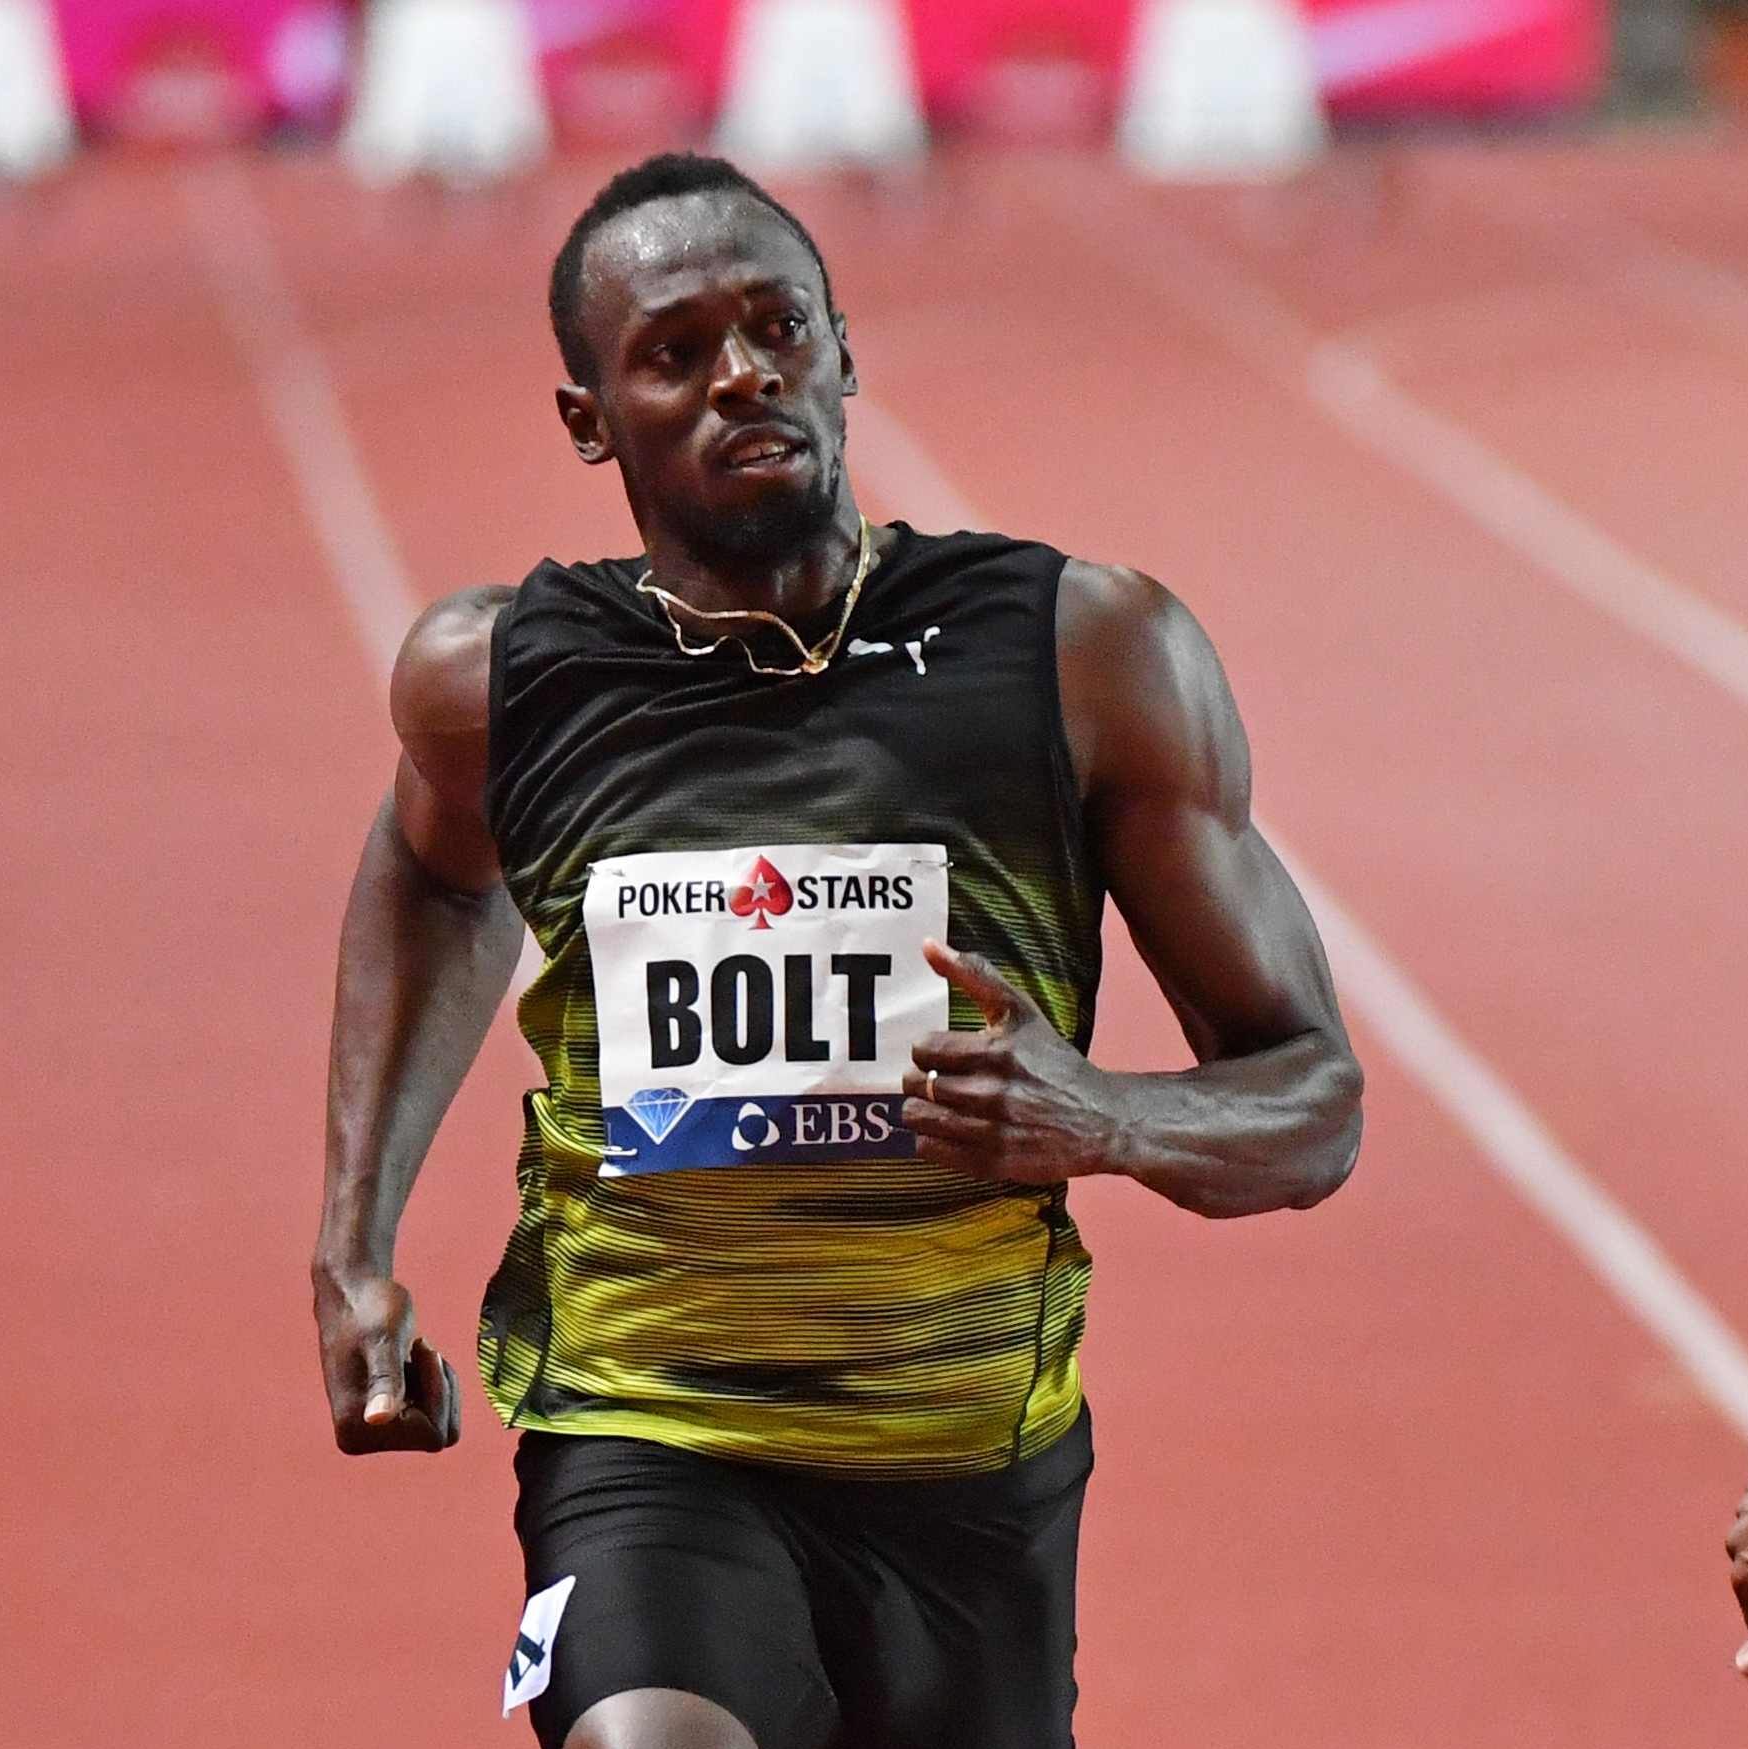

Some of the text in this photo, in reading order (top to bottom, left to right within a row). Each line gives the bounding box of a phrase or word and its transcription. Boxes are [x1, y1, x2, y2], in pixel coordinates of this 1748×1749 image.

[618, 875, 913, 919] POKER STARS
[645, 953, 893, 1070] BOLT
[791, 1101, 892, 1146] EBS
